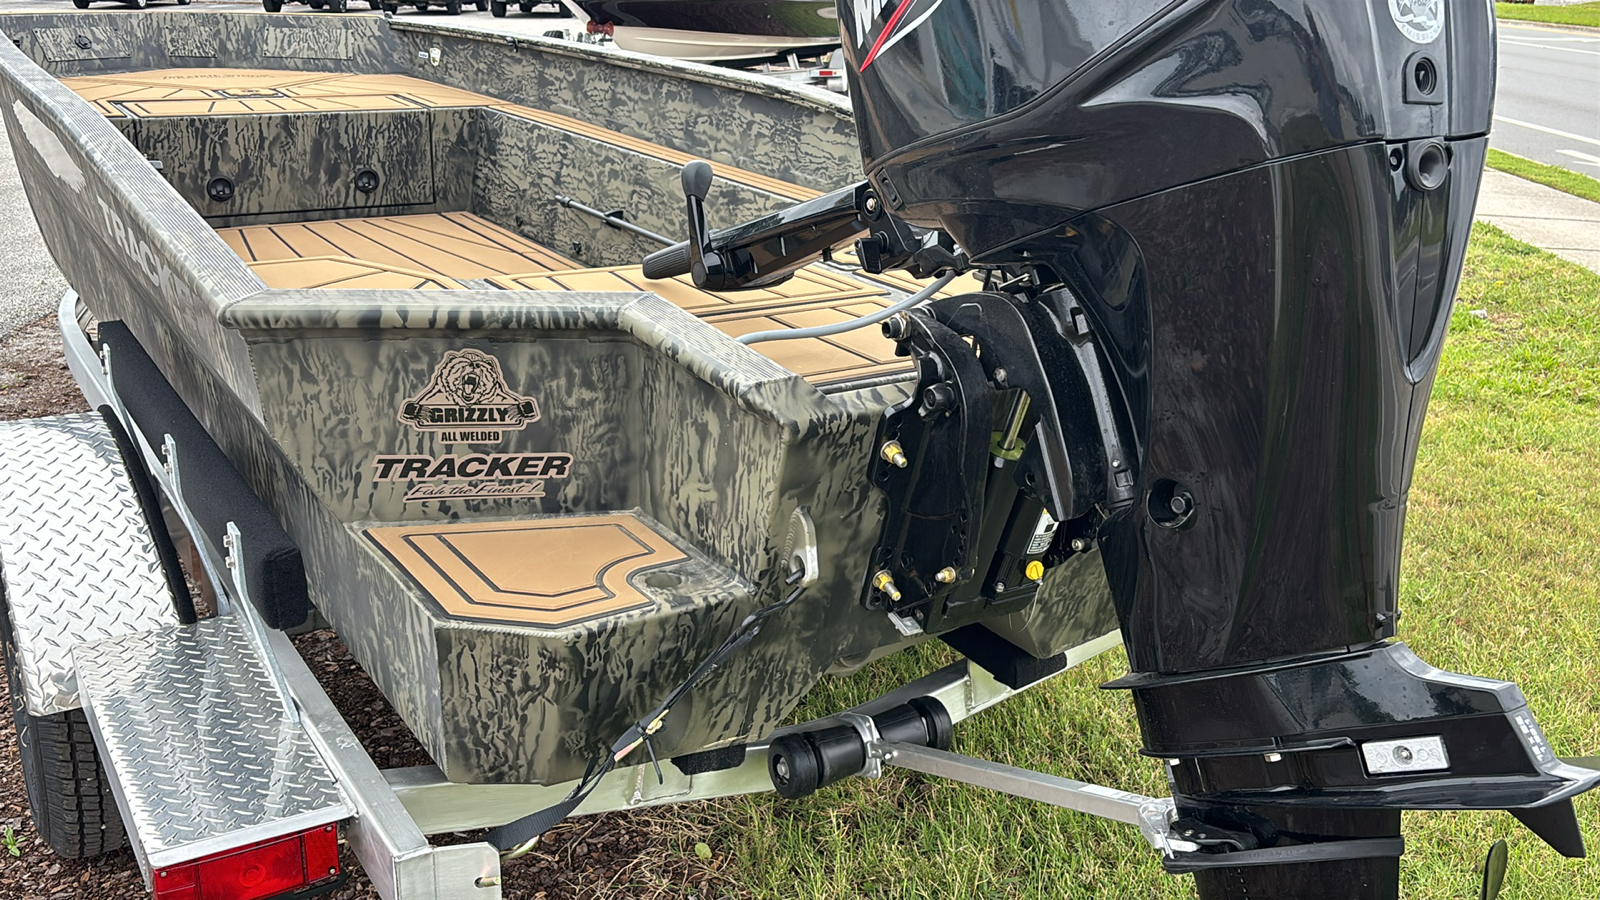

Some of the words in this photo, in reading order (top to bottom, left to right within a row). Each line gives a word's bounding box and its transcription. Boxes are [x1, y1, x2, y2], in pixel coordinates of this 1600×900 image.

[430, 407, 508, 423] GRIZZLY
[441, 431, 458, 442] ALL
[460, 431, 500, 442] WELDED
[376, 456, 571, 479] TRACKER
[411, 485, 445, 496] Fish
[450, 484, 474, 495] the
